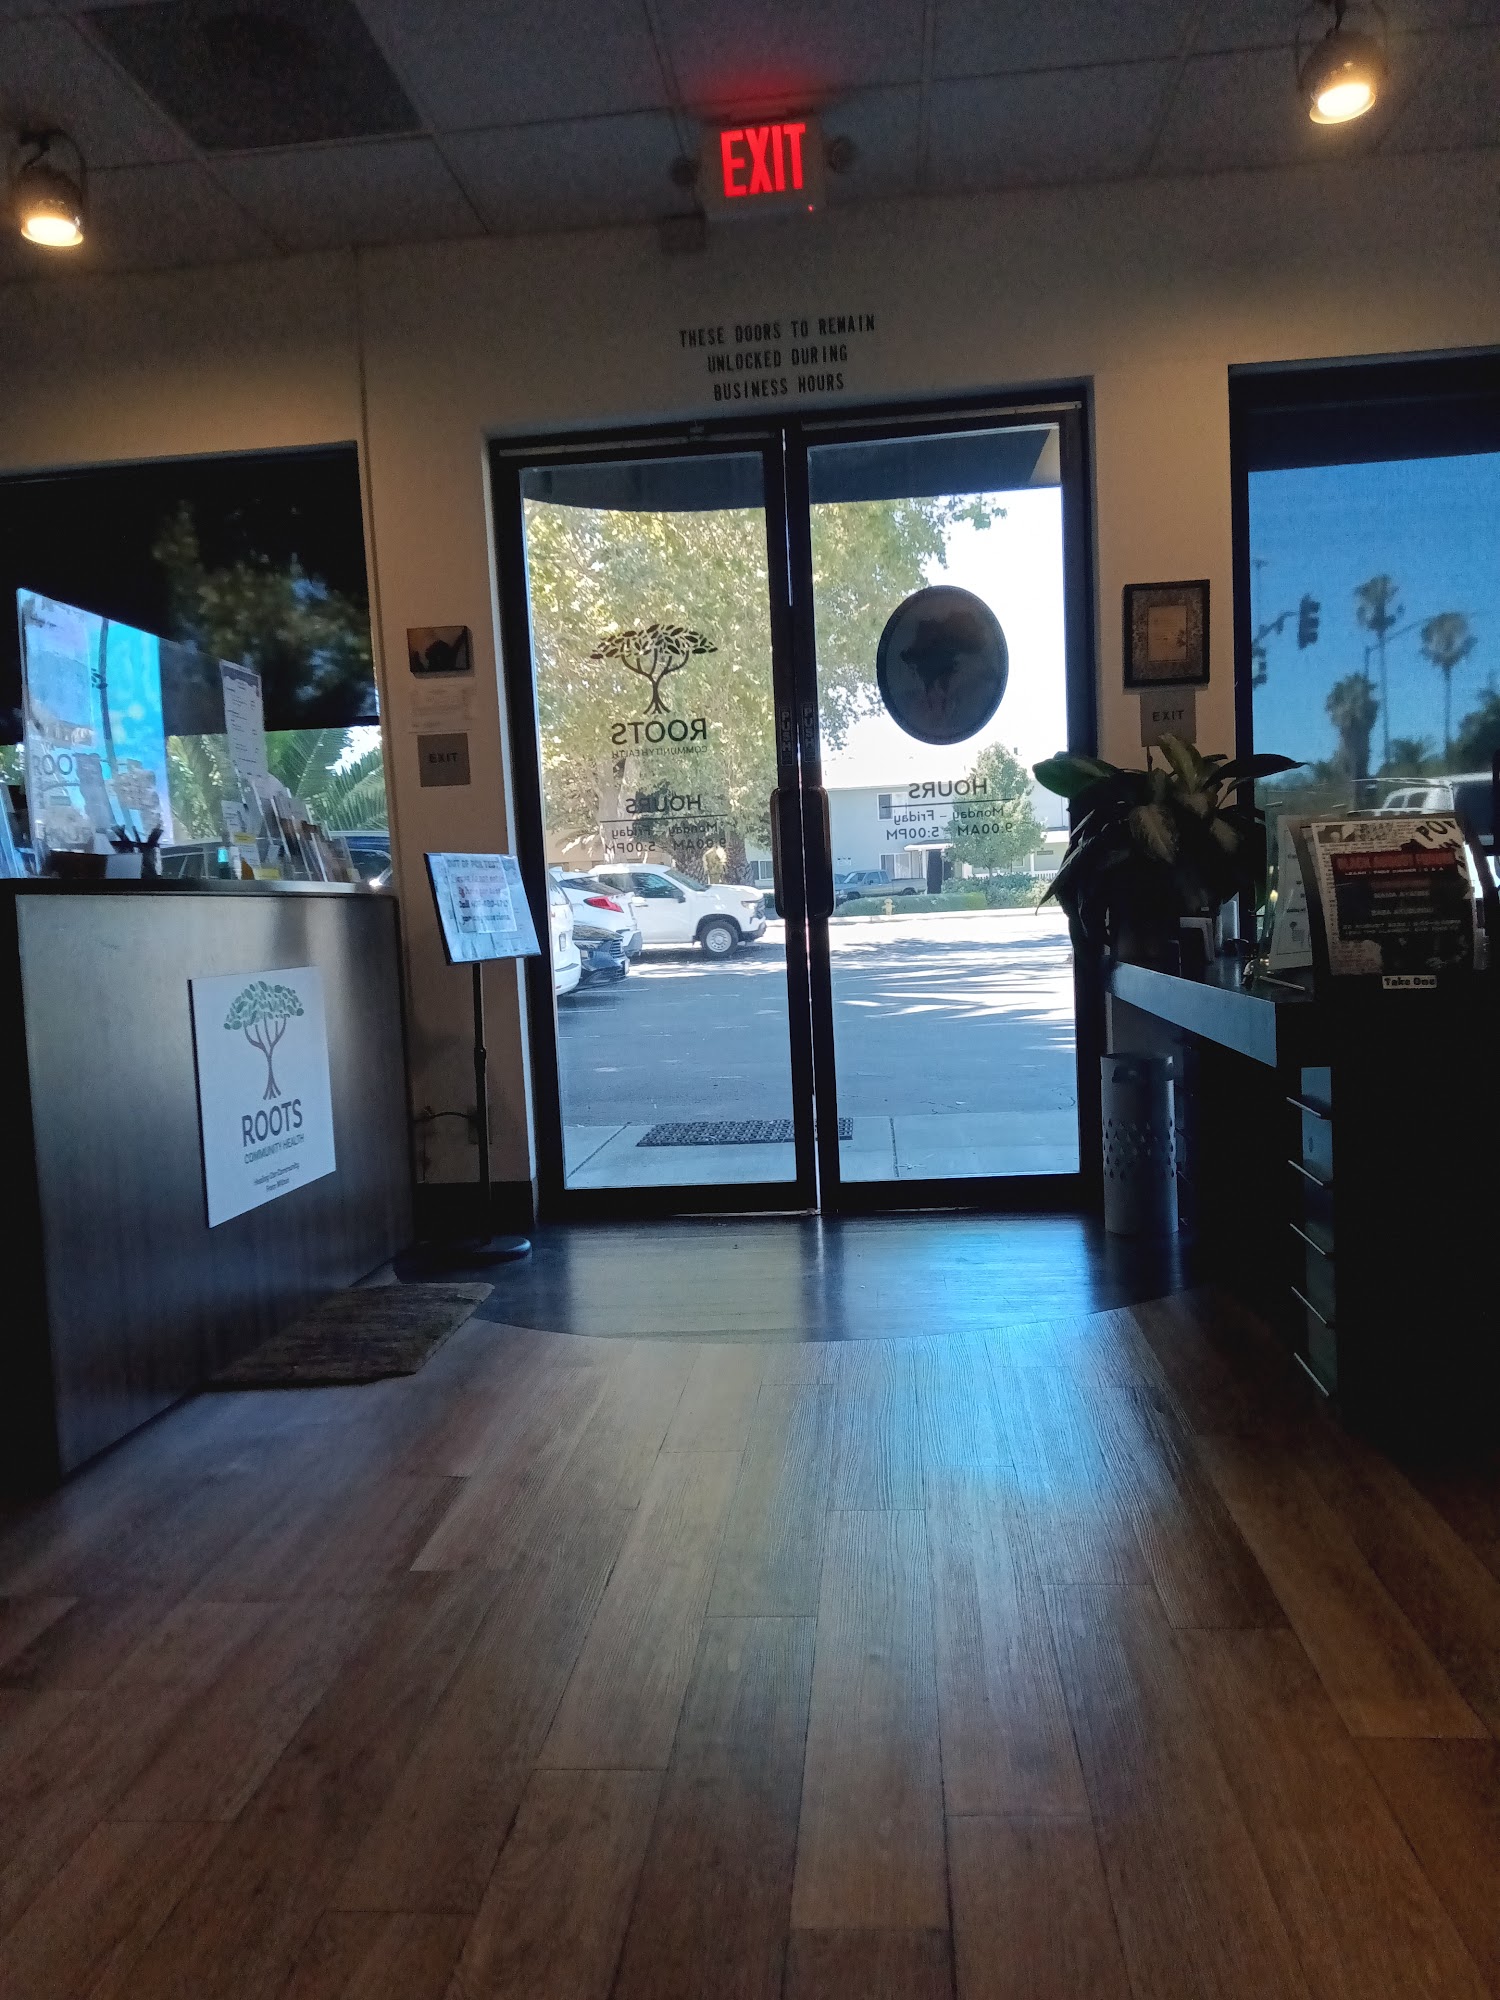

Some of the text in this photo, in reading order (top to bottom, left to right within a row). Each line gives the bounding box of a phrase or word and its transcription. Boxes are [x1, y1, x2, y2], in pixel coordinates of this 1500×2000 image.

[720, 122, 806, 198] EXIT
[679, 313, 876, 348] THESE DOORS TO REMAIN
[707, 345, 848, 373] UNLOCKED DURING
[713, 374, 845, 401] BUSINESS HOURS
[1152, 709, 1185, 722] EXIT
[428, 752, 458, 764] EXIT
[1384, 976, 1435, 986] Take One
[242, 1099, 303, 1147] ROOTS
[244, 1133, 305, 1164] COMMUNITY HEALTH
